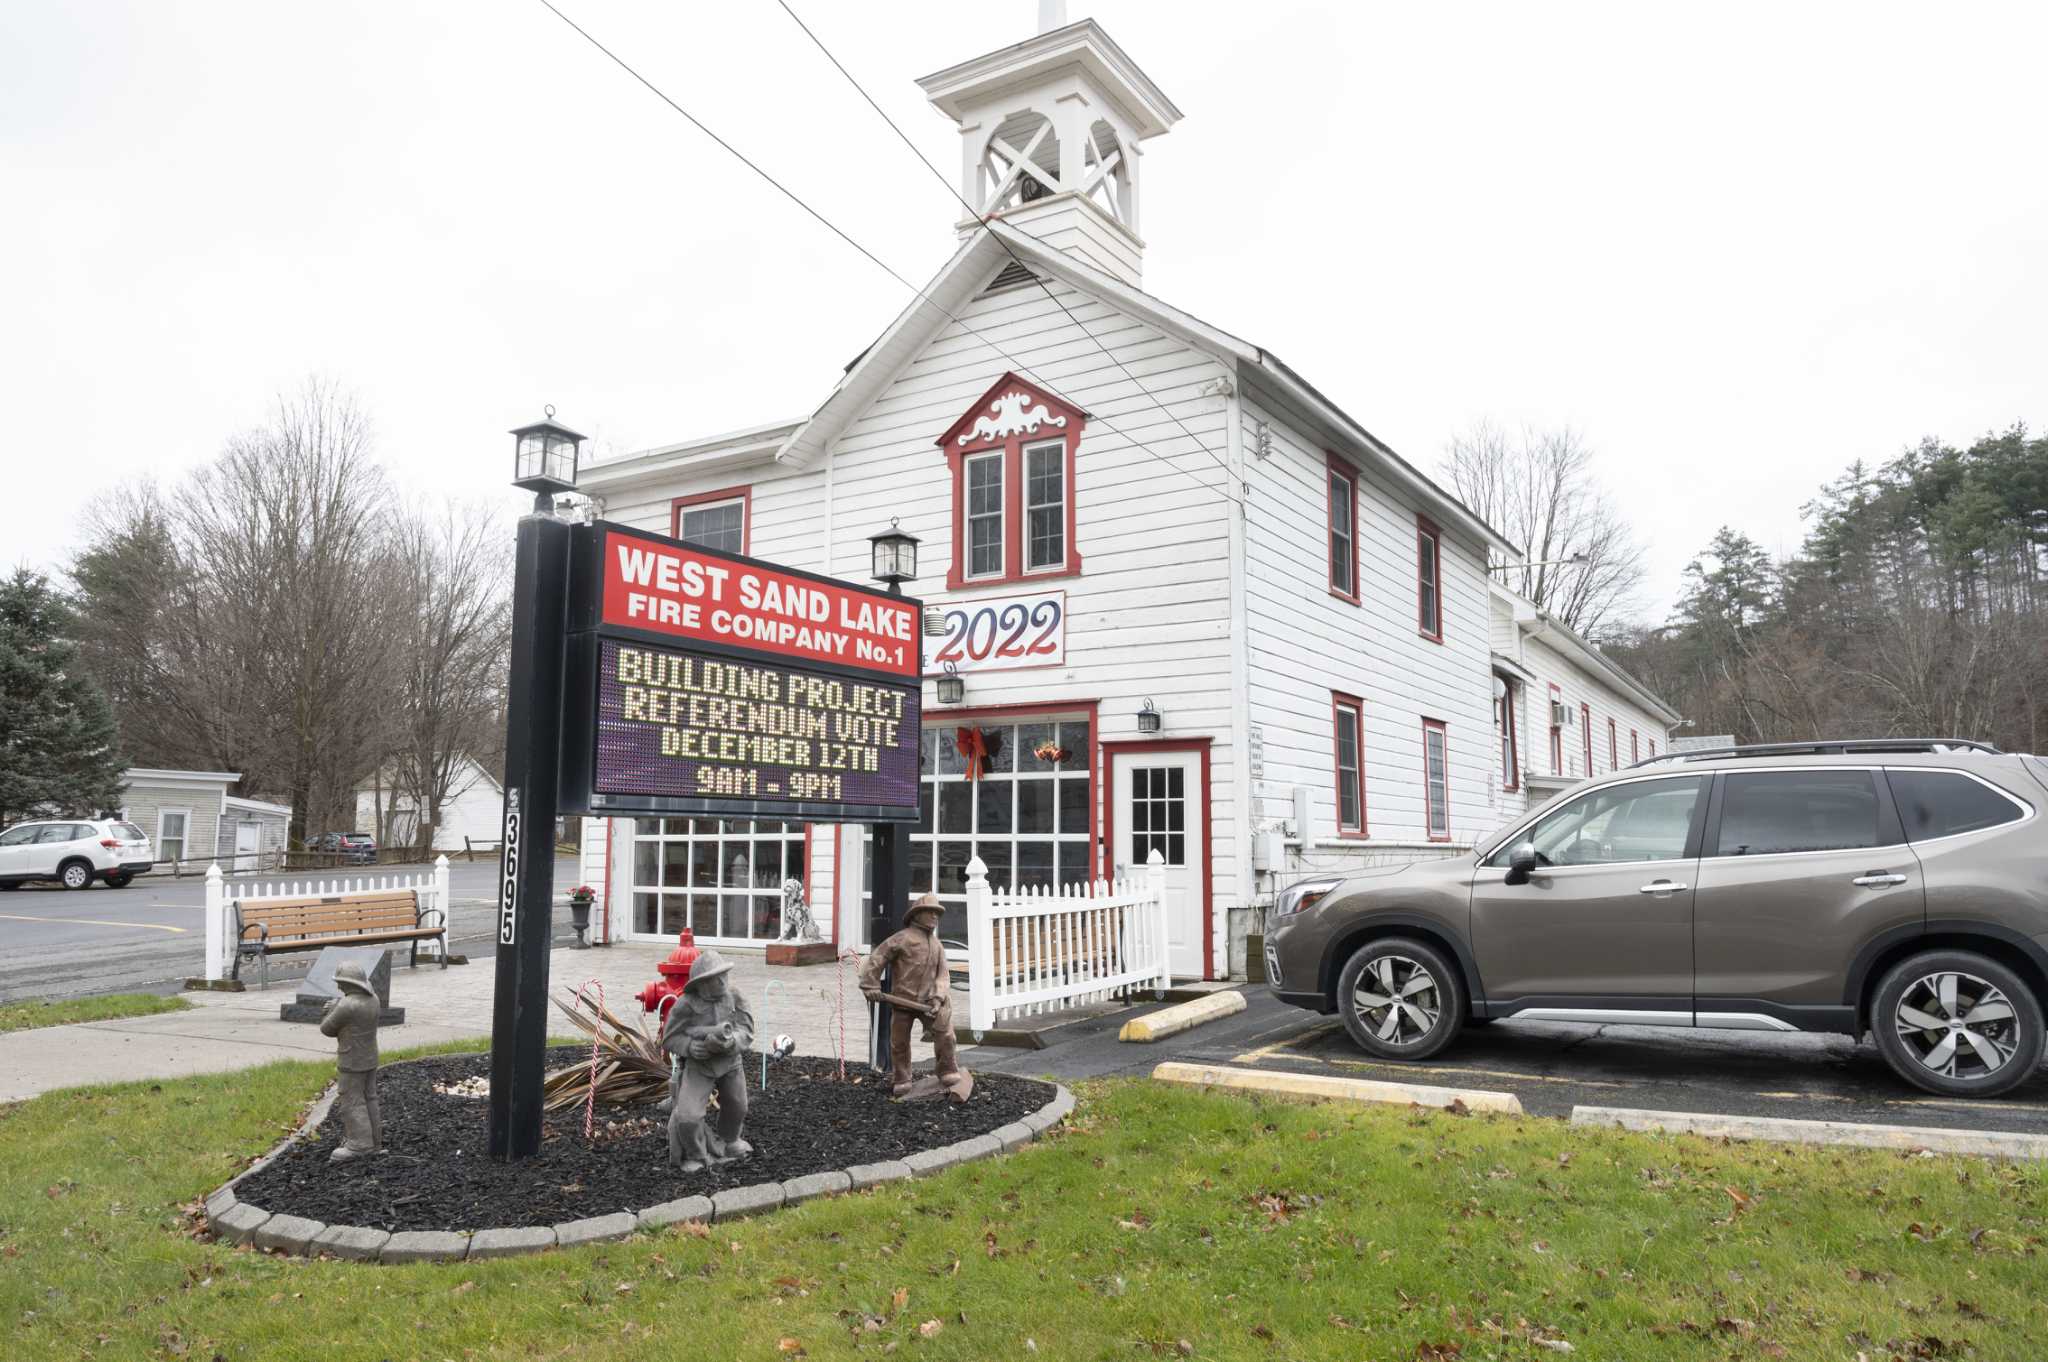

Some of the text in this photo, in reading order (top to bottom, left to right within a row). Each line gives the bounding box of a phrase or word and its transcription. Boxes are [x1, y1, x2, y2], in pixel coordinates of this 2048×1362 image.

[618, 545, 912, 641] WEST SAND LAKE
[628, 592, 904, 666] FIRE COMPANY No.1
[934, 600, 1061, 664] 2022
[619, 648, 906, 718] BUILDING PROJECT
[624, 686, 899, 747] REFERENDUM VOTE
[662, 727, 878, 771] DECEMBER 12TH
[697, 766, 757, 795] 9AM
[789, 772, 841, 800] 9PM
[502, 814, 518, 943] 3695
